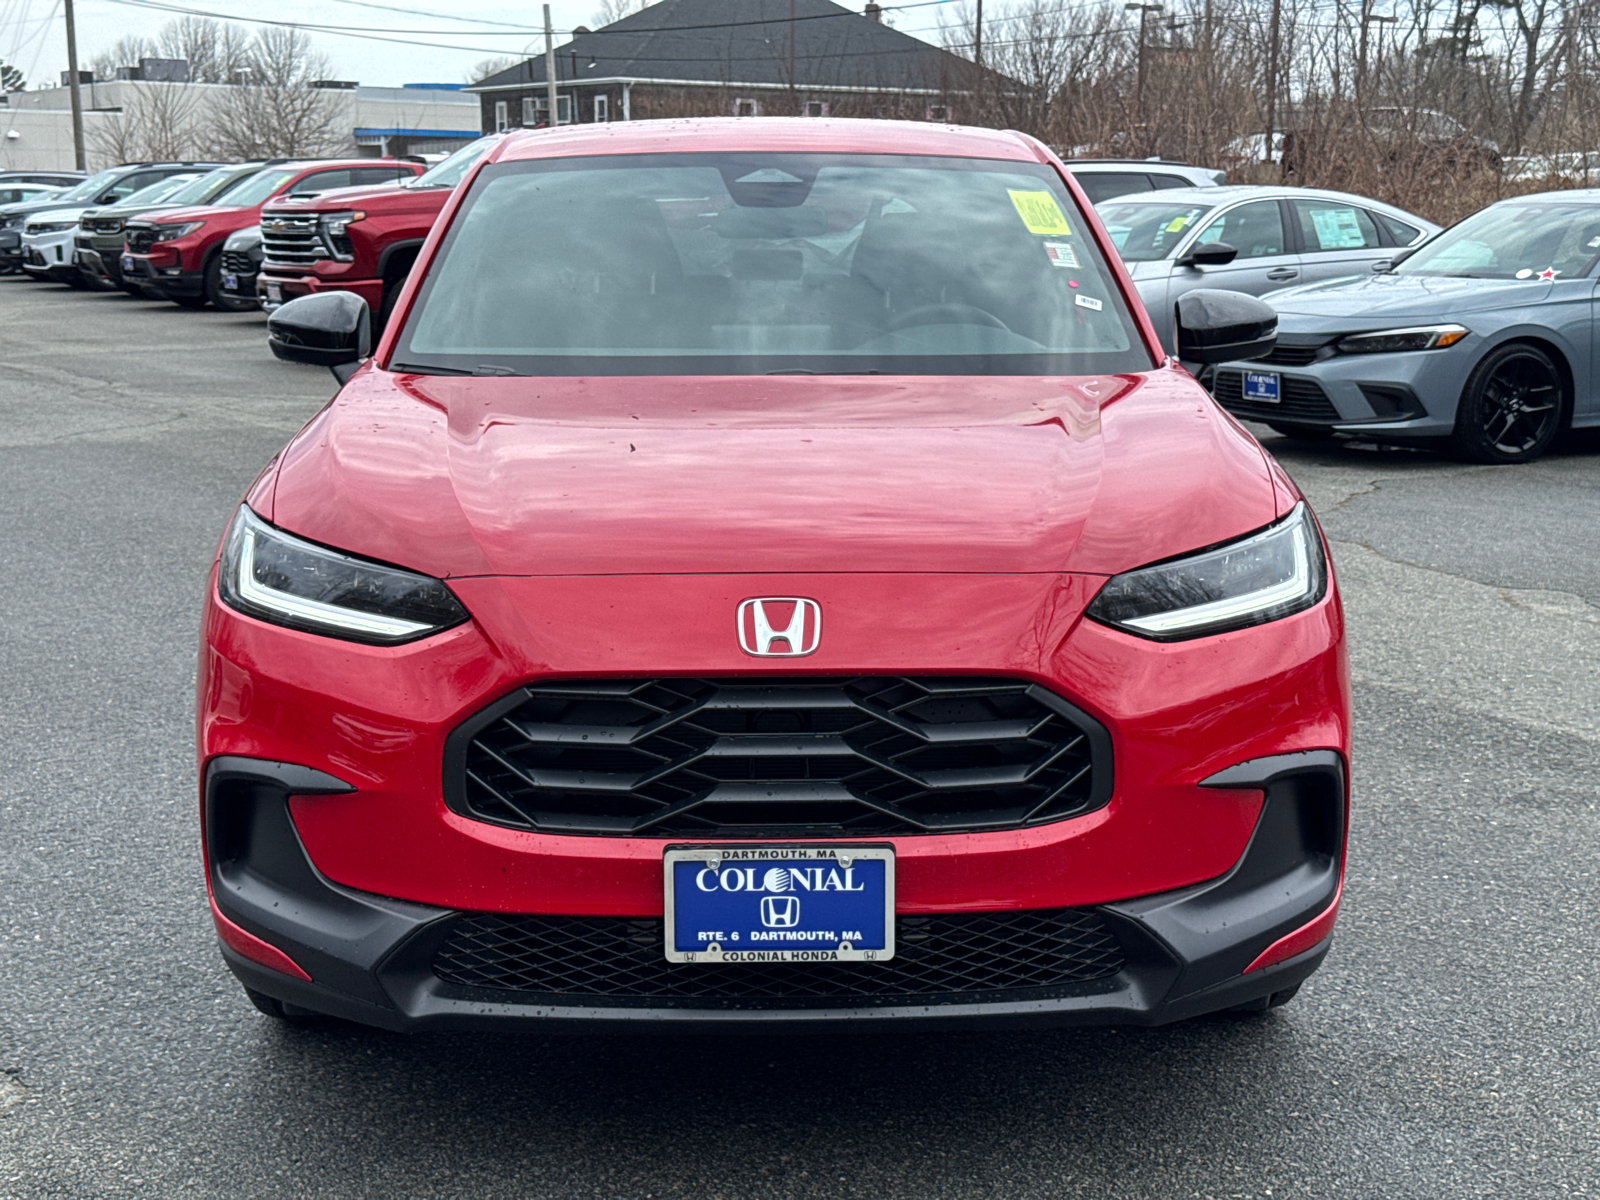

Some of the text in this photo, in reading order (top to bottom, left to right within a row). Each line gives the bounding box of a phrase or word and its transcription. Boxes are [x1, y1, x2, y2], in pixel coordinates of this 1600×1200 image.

[722, 850, 837, 859] DARTMOUTH, MA
[696, 867, 865, 893] COLONIAL
[697, 931, 863, 942] RTE. 6 DARTMOUTH, MA
[722, 951, 838, 962] COLONIAL HONDA
